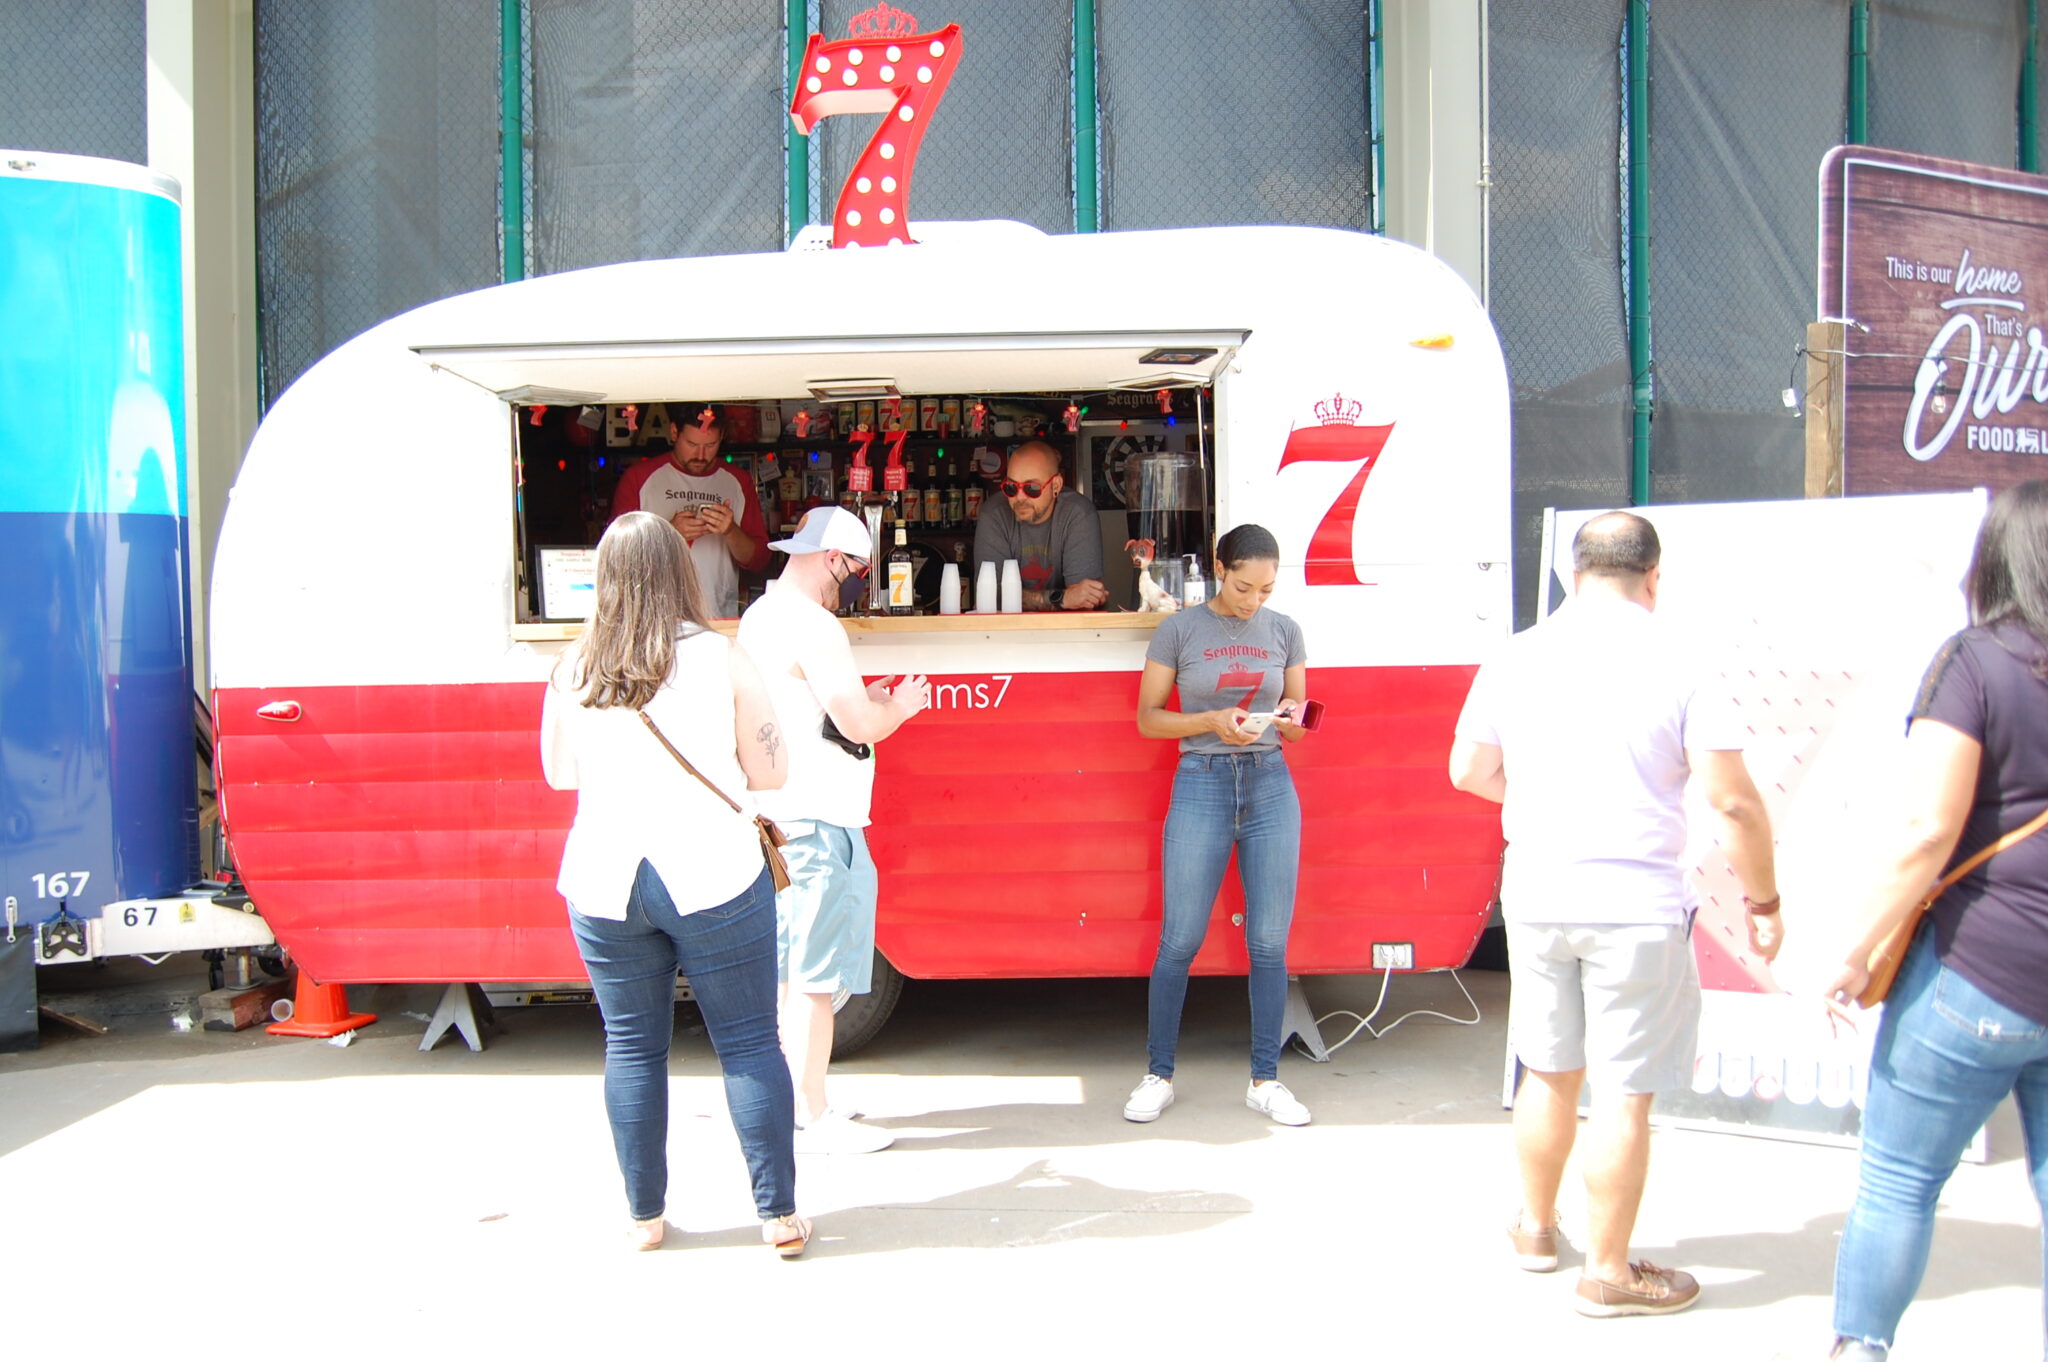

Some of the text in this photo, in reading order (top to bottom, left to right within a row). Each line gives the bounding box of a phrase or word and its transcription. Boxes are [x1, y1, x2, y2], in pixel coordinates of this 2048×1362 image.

[790, 22, 964, 249] 7
[1886, 248, 2022, 294] This is our home
[1985, 313, 2023, 337] That's
[1903, 313, 2048, 461] Our
[902, 408, 915, 431] 7
[923, 407, 936, 429] 7
[848, 430, 907, 467] 7 7
[1967, 426, 2016, 451] FOOD
[665, 489, 722, 504] Seagram's
[904, 498, 918, 519] 7
[967, 496, 981, 518] 7
[1276, 420, 1396, 586] 7
[890, 574, 908, 604] 7
[1203, 644, 1270, 661] Seagram's
[900, 675, 1013, 710] ams7
[1215, 671, 1265, 718] 7
[31, 871, 91, 899] 167
[123, 907, 158, 927] 67
